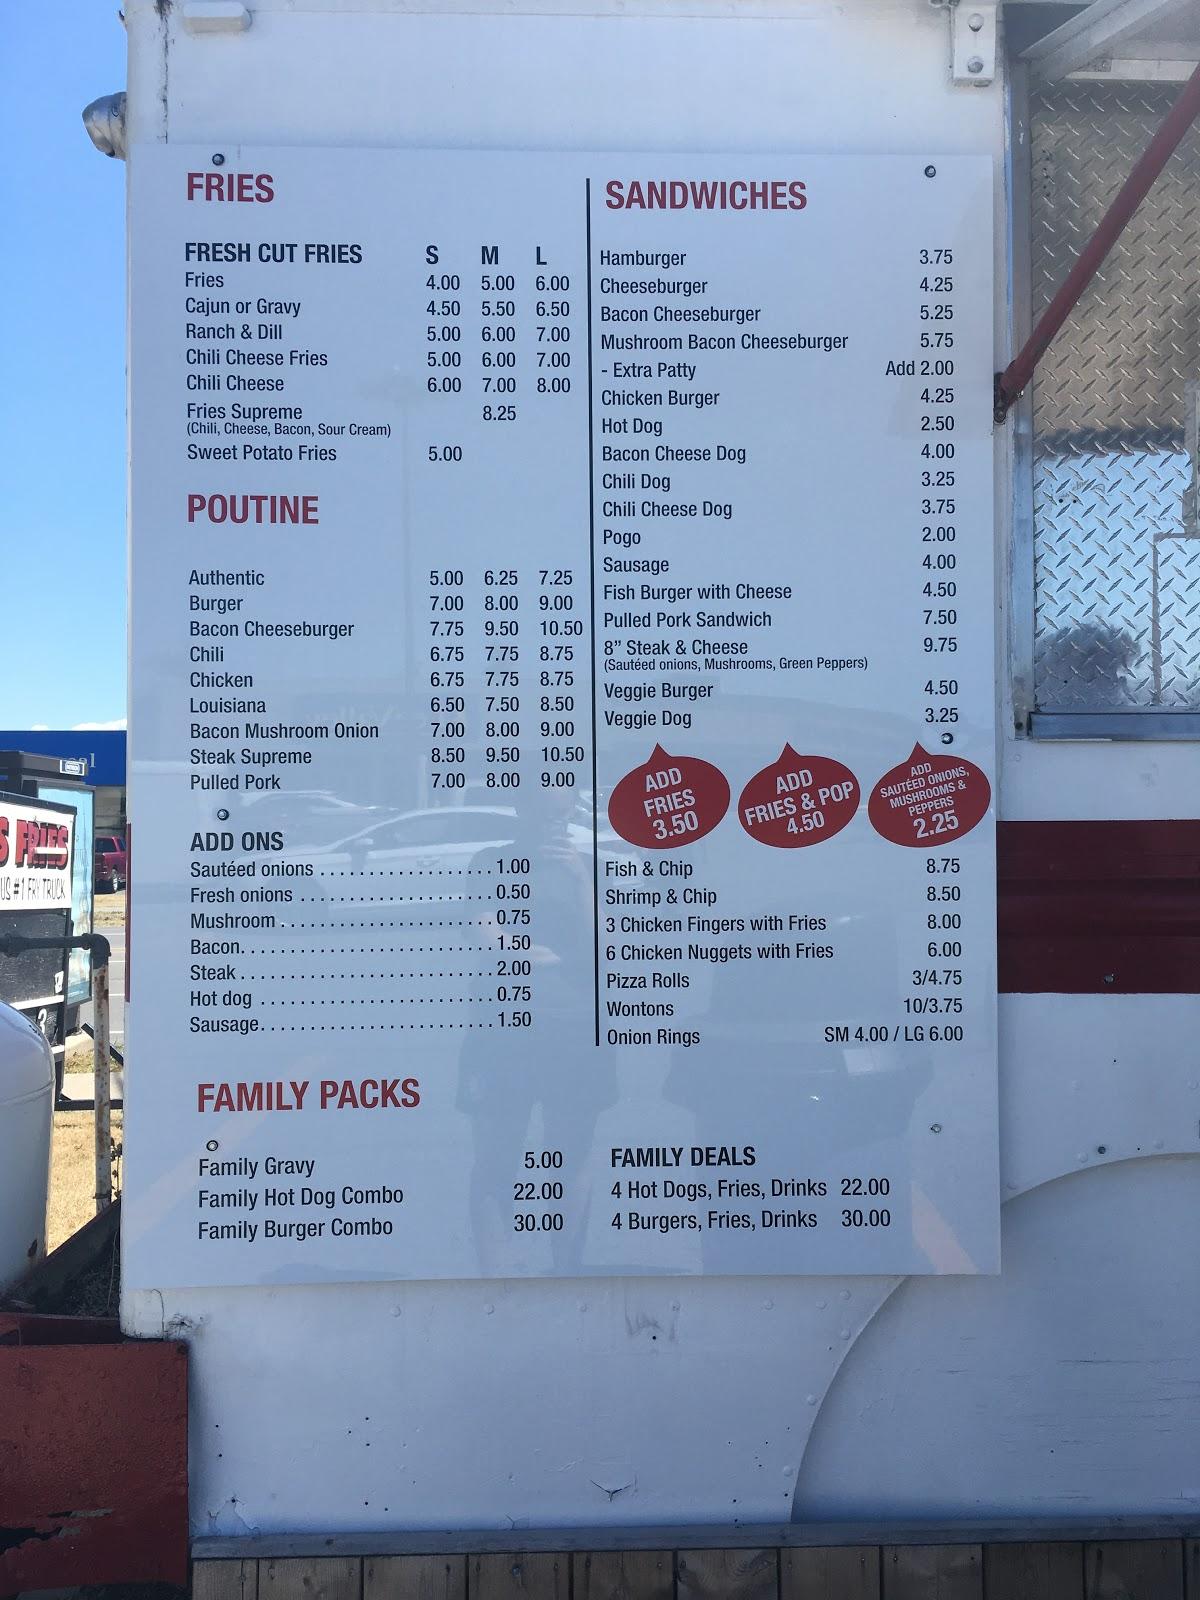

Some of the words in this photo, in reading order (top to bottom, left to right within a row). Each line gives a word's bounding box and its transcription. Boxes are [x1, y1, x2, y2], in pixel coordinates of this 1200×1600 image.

[187, 172, 275, 204] FRIES
[605, 180, 808, 211] SANDWICHES
[185, 242, 251, 263] FRESH
[257, 242, 299, 264] CUT
[304, 243, 363, 264] FRIES
[425, 244, 439, 265] S
[481, 245, 499, 266] M
[535, 245, 548, 266] L
[600, 249, 687, 270] Hamburger
[919, 248, 953, 265] 3.75
[600, 277, 709, 298] Cheeseburger
[919, 276, 954, 293] 4.25
[185, 296, 230, 317] Cajun
[235, 301, 252, 314] or
[256, 297, 302, 319] Gravy
[426, 300, 461, 317] 4.50
[481, 300, 516, 317] 5.50
[535, 300, 570, 317] 6.50
[601, 333, 683, 350] Mushroom
[688, 333, 736, 350] Bacon
[740, 333, 849, 353] Cheeseburger
[920, 332, 954, 348] 5.75
[186, 348, 221, 365] Chili
[225, 348, 284, 366] Cheese
[289, 349, 328, 367] Fries
[427, 351, 462, 368] 5.00
[481, 351, 516, 368] 6.00
[536, 351, 571, 368] 7.00
[601, 389, 663, 406] Chicken
[668, 389, 721, 409] Burger
[920, 387, 955, 404] 4.25
[186, 402, 227, 420] Fries
[231, 402, 303, 423] Supreme
[482, 405, 517, 421] 8.25
[186, 421, 221, 437] (Chili,
[223, 421, 271, 437] Cheese,
[274, 422, 315, 438] Bacon,
[317, 422, 346, 436] Sour
[348, 423, 392, 439] Cream)
[602, 445, 650, 462] Bacon
[654, 445, 712, 462] Cheese
[716, 445, 746, 465] Dog
[920, 443, 955, 459] 4.00
[187, 493, 319, 525] POUTINE
[602, 500, 636, 518] Chili
[641, 500, 698, 517] Cheese
[702, 500, 733, 520] Dog
[921, 498, 956, 515] 3.75
[602, 556, 670, 576] Sausage
[922, 553, 957, 570] 4.00
[188, 569, 265, 586] Authentic
[429, 570, 464, 586] 5.00
[484, 569, 519, 586] 6.25
[538, 569, 573, 586] 7.25
[603, 611, 651, 628] Pulled
[656, 611, 692, 628] Pork
[696, 610, 772, 628] Sandwich
[922, 609, 958, 625] 7.50
[189, 620, 239, 637] Bacon
[244, 620, 355, 641] Cheeseburger
[429, 620, 465, 637] 7.75
[484, 620, 519, 637] 9.50
[539, 620, 584, 636] 10.50
[603, 657, 656, 674] (Sautéed
[658, 660, 701, 672] onions,
[704, 657, 776, 672] Mushrooms,
[779, 656, 813, 670] Green
[816, 656, 868, 672] Peppers)
[189, 671, 254, 688] Chicken
[430, 671, 465, 688] 6.75
[485, 671, 520, 687] 7.75
[539, 670, 574, 687] 8.75
[924, 679, 959, 696] 4.50
[603, 682, 657, 702] Veggie
[661, 682, 714, 702] Burger
[603, 709, 657, 730] Veggie
[661, 710, 692, 729] Dog
[924, 707, 959, 724] 3.25
[190, 748, 236, 765] Steak
[240, 748, 312, 768] Supreme
[430, 747, 466, 764] 8.50
[485, 746, 520, 763] 9.50
[541, 746, 585, 762] 10.50
[910, 762, 932, 777] ADD
[190, 773, 240, 791] Pulled
[244, 773, 281, 790] Pork
[431, 772, 466, 789] 7.00
[486, 772, 521, 788] 8.00
[540, 771, 575, 788] 9.00
[645, 767, 682, 793] ADD
[776, 769, 813, 795] ADD
[880, 778, 926, 798] SAUTÉED
[927, 766, 970, 785] ONIONS,
[643, 788, 696, 818] FRIES
[889, 782, 956, 809] MUSHROOMS
[957, 779, 967, 790] &
[744, 797, 797, 826] FRIES
[800, 792, 816, 811] &
[818, 781, 854, 806] POP
[908, 796, 954, 817] PEPPERS
[652, 810, 699, 840] 3.50
[787, 810, 825, 834] 4.50
[913, 809, 959, 839] 2.25
[15, 818, 69, 871] FRIES
[189, 832, 235, 852] ADD
[241, 831, 284, 852] ONS
[28, 877, 40, 900] FRY
[43, 878, 66, 900] TRUCK
[190, 886, 235, 904] Fresh
[240, 886, 293, 903] onions
[496, 883, 531, 900] 0.50
[605, 888, 662, 908] Shrimp
[666, 888, 678, 905] &
[682, 887, 718, 908] Chip
[926, 885, 961, 902] 8.50
[190, 912, 276, 929] Mushroom
[496, 909, 531, 926] 0.75
[190, 938, 240, 955] Bacon
[497, 934, 531, 951] 1.50
[927, 941, 962, 958] 6.00
[605, 944, 616, 961] 6
[620, 944, 683, 961] Chicken
[688, 943, 753, 964] Nuggets
[756, 942, 791, 959] with
[795, 942, 834, 959] Fries
[190, 990, 218, 1007] Hot
[222, 989, 252, 1010] dog
[496, 985, 532, 1002] 0.75
[606, 1000, 675, 1017] Wontons
[903, 997, 963, 1014] 10/3.75
[197, 1080, 310, 1113] FAMILY
[320, 1077, 421, 1110] PACKS
[611, 1147, 684, 1168] FAMILY
[690, 1145, 756, 1167] DEALS
[513, 1181, 564, 1201] 22.00
[610, 1181, 623, 1199] 4
[628, 1180, 658, 1199] Hot
[663, 1180, 712, 1202] Dogs,
[717, 1178, 766, 1201] Fries,
[771, 1178, 828, 1197] Drinks
[840, 1177, 890, 1196] 22.00
[198, 1188, 259, 1212] Family
[264, 1188, 296, 1207] Hot
[301, 1187, 336, 1210] Dog
[341, 1185, 404, 1205] Combo
